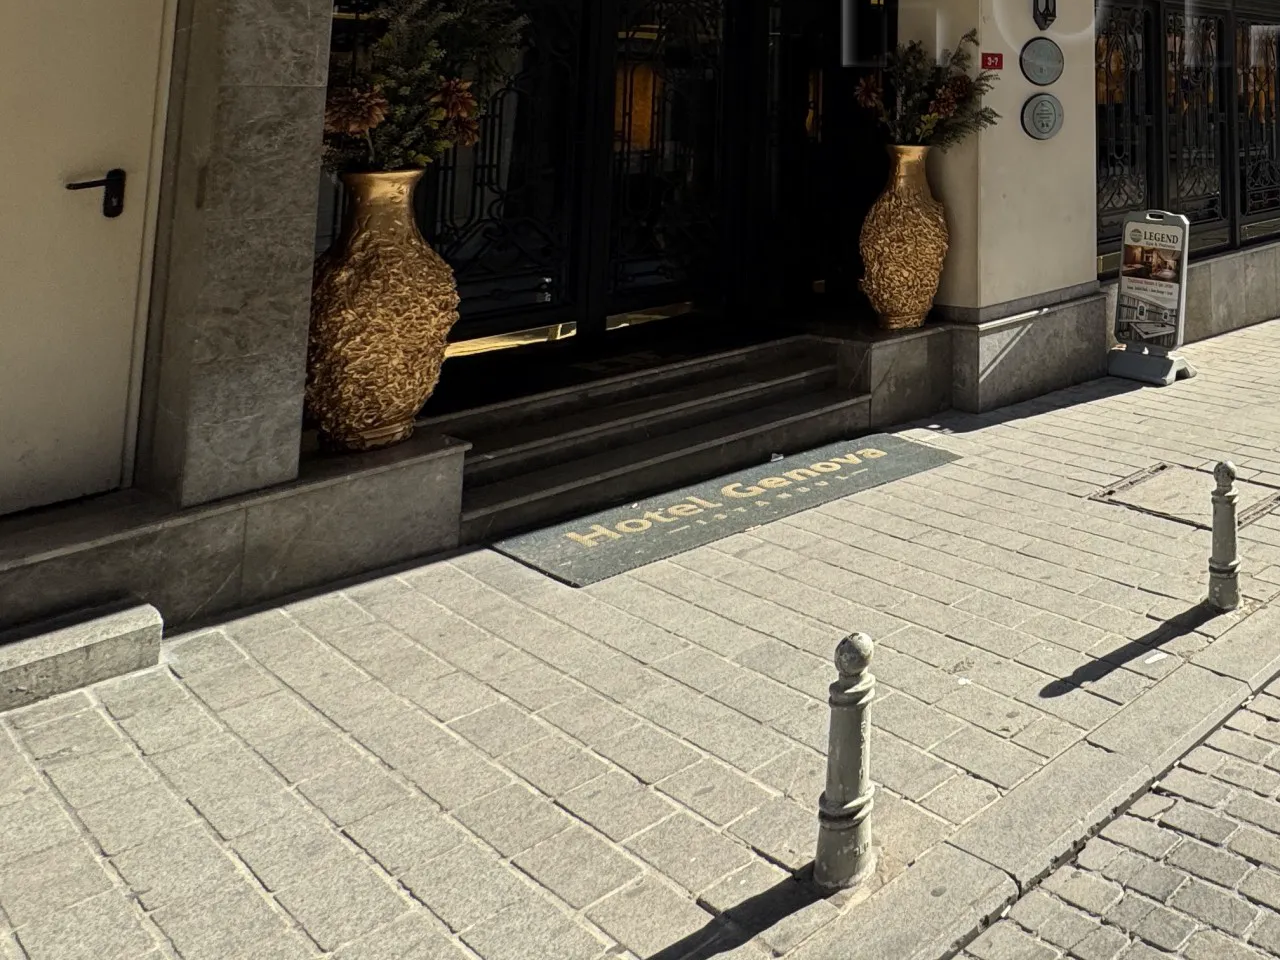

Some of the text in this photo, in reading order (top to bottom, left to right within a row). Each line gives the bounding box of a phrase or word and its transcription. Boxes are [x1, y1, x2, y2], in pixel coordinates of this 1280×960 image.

[987, 56, 999, 66] 3-7
[1144, 230, 1178, 244] LEGEND
[565, 447, 888, 547] Hotel Genova
